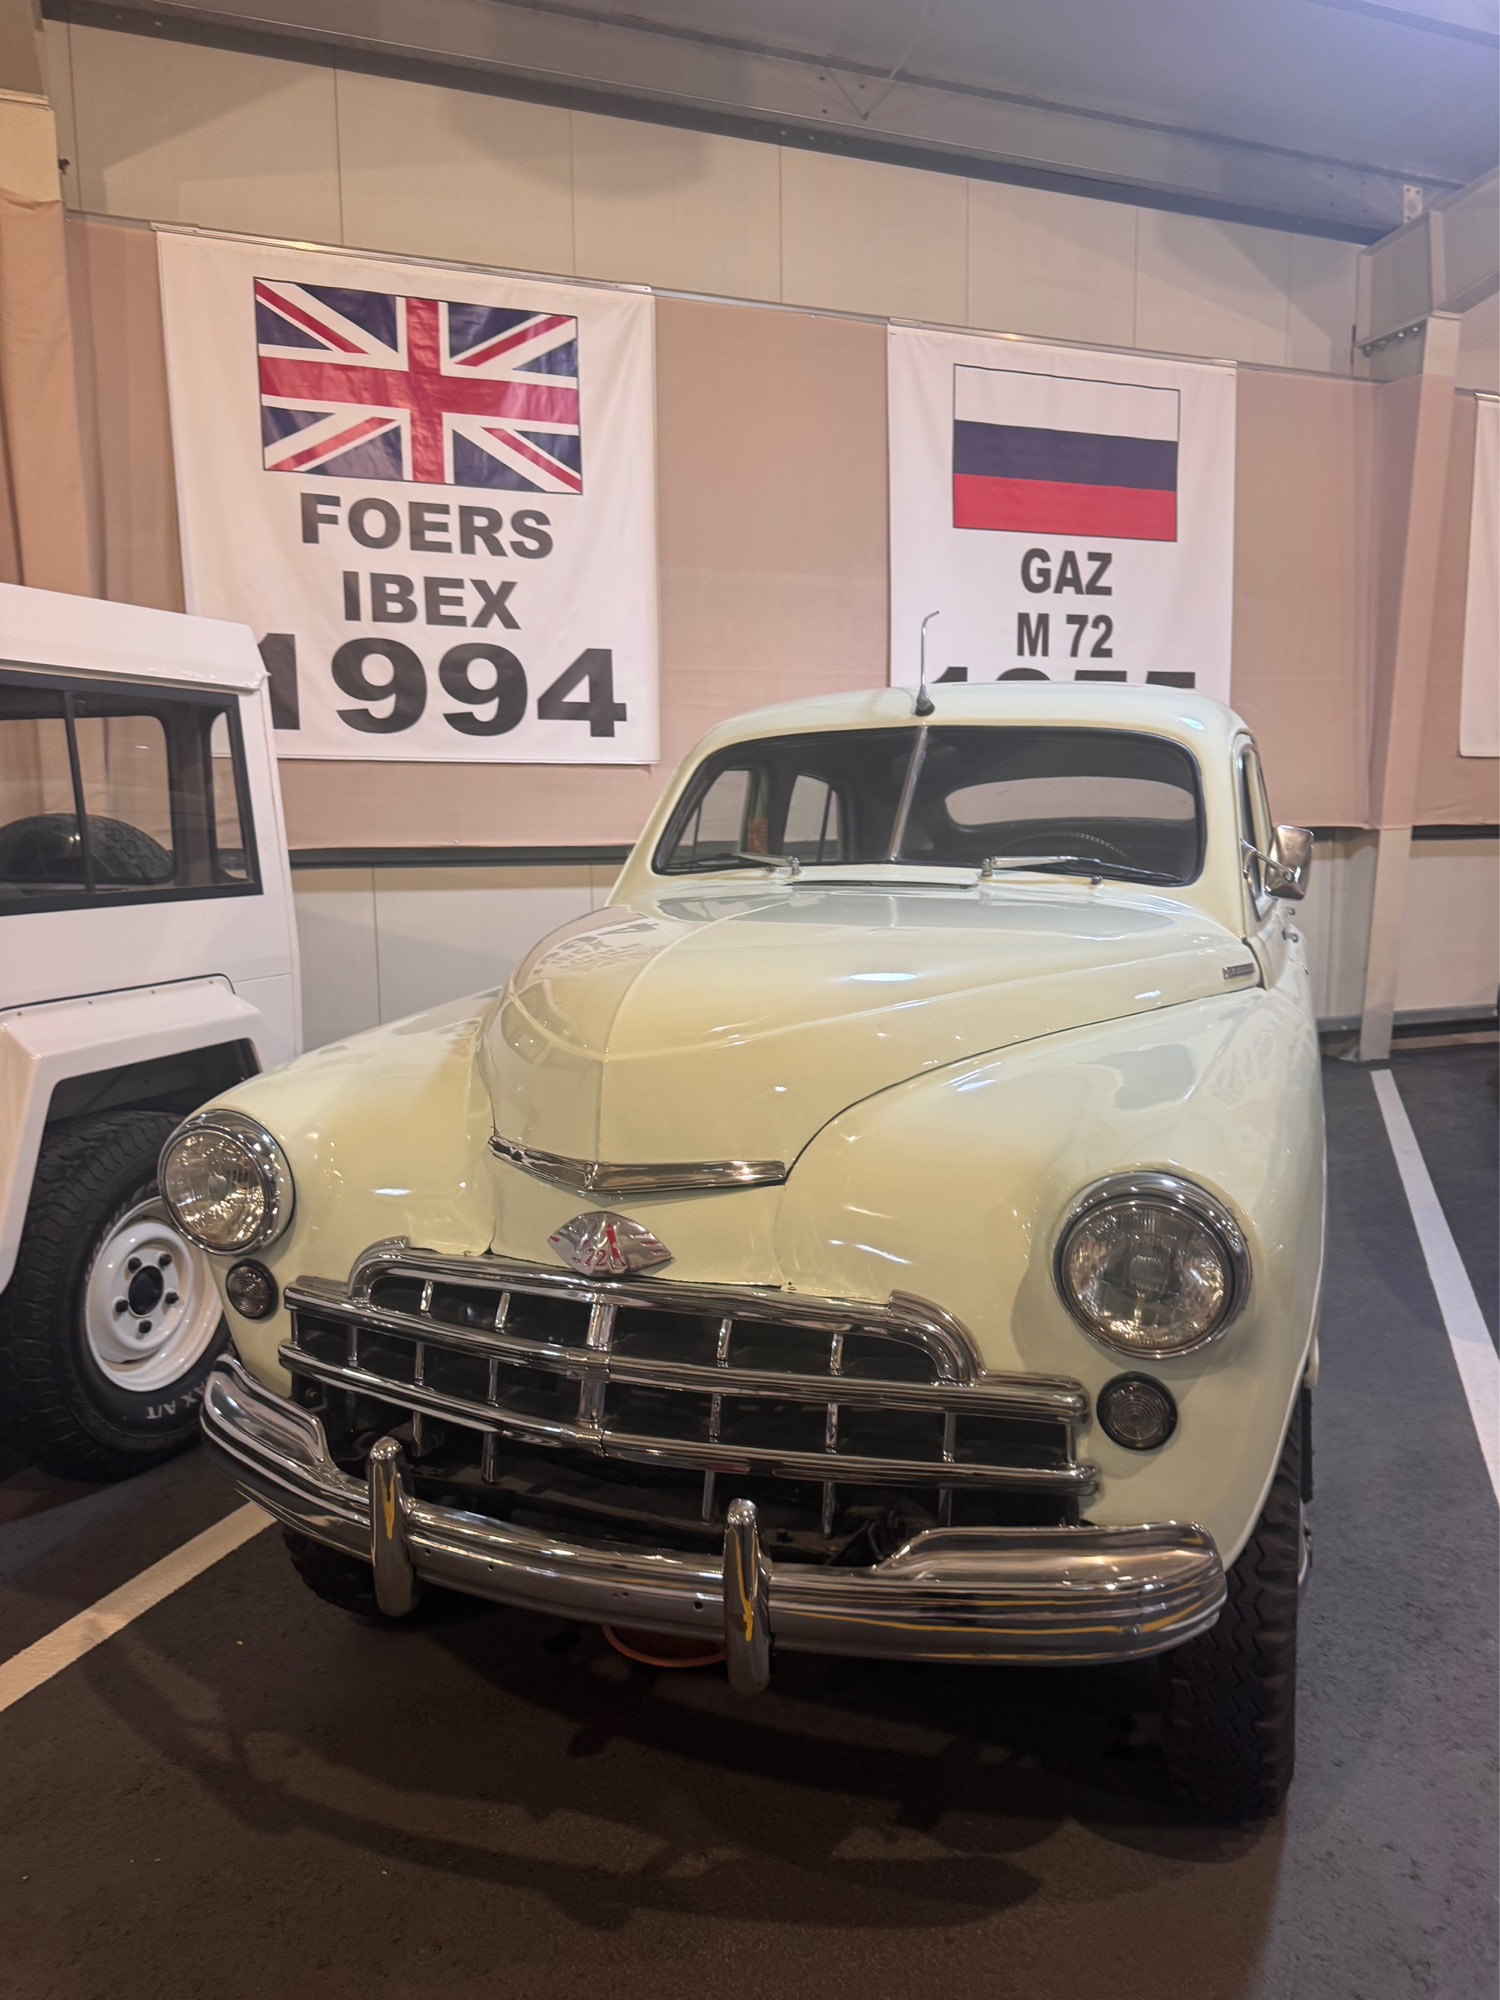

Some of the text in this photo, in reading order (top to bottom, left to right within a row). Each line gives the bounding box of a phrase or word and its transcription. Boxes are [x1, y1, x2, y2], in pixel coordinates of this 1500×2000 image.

[301, 492, 554, 559] FOERS
[343, 571, 521, 630] IBEX
[1021, 548, 1112, 596] GAZ
[1017, 612, 1113, 658] M 72
[258, 632, 627, 738] 1994
